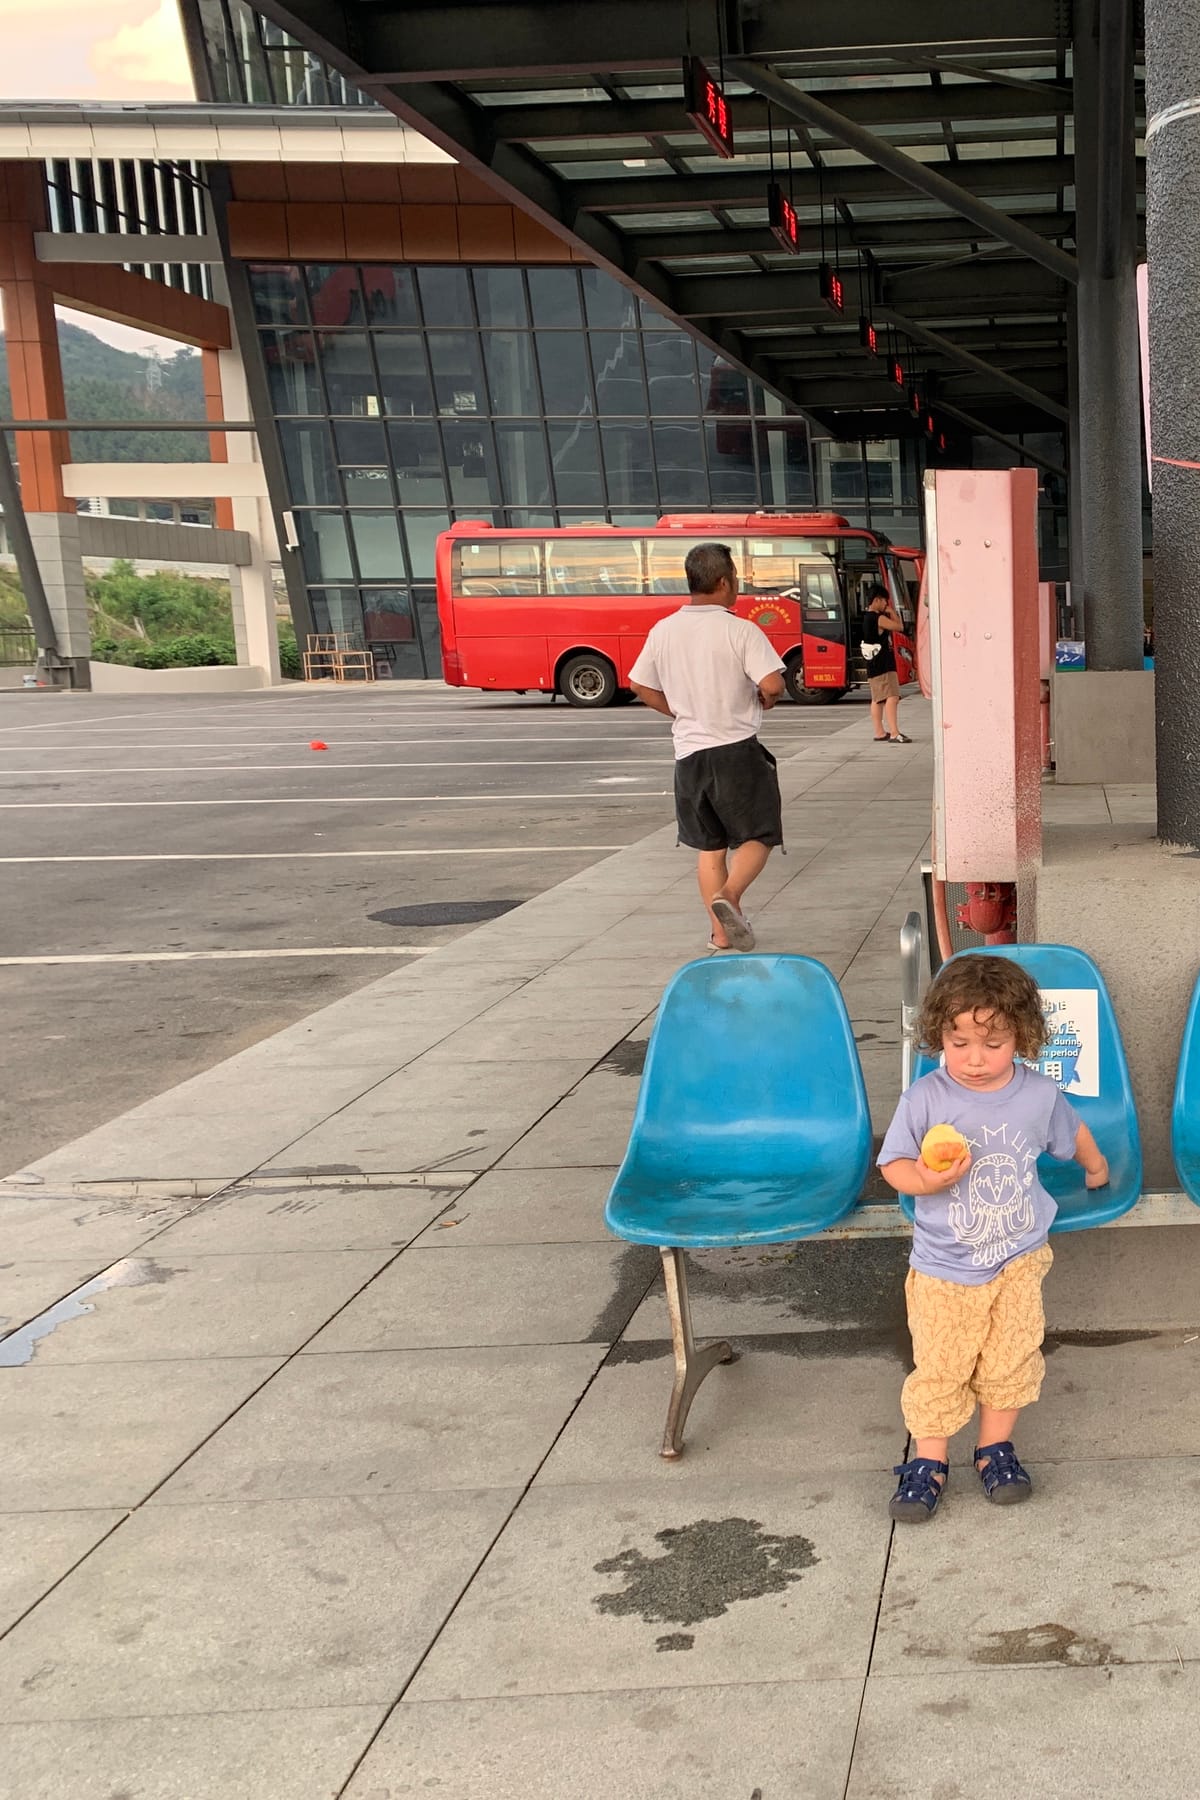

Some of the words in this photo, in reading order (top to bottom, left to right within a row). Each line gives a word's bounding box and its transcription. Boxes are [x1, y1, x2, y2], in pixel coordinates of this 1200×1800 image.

[1054, 1037, 1083, 1048] during
[1051, 1050, 1079, 1060] period
[964, 1123, 1037, 1172] AMUK
